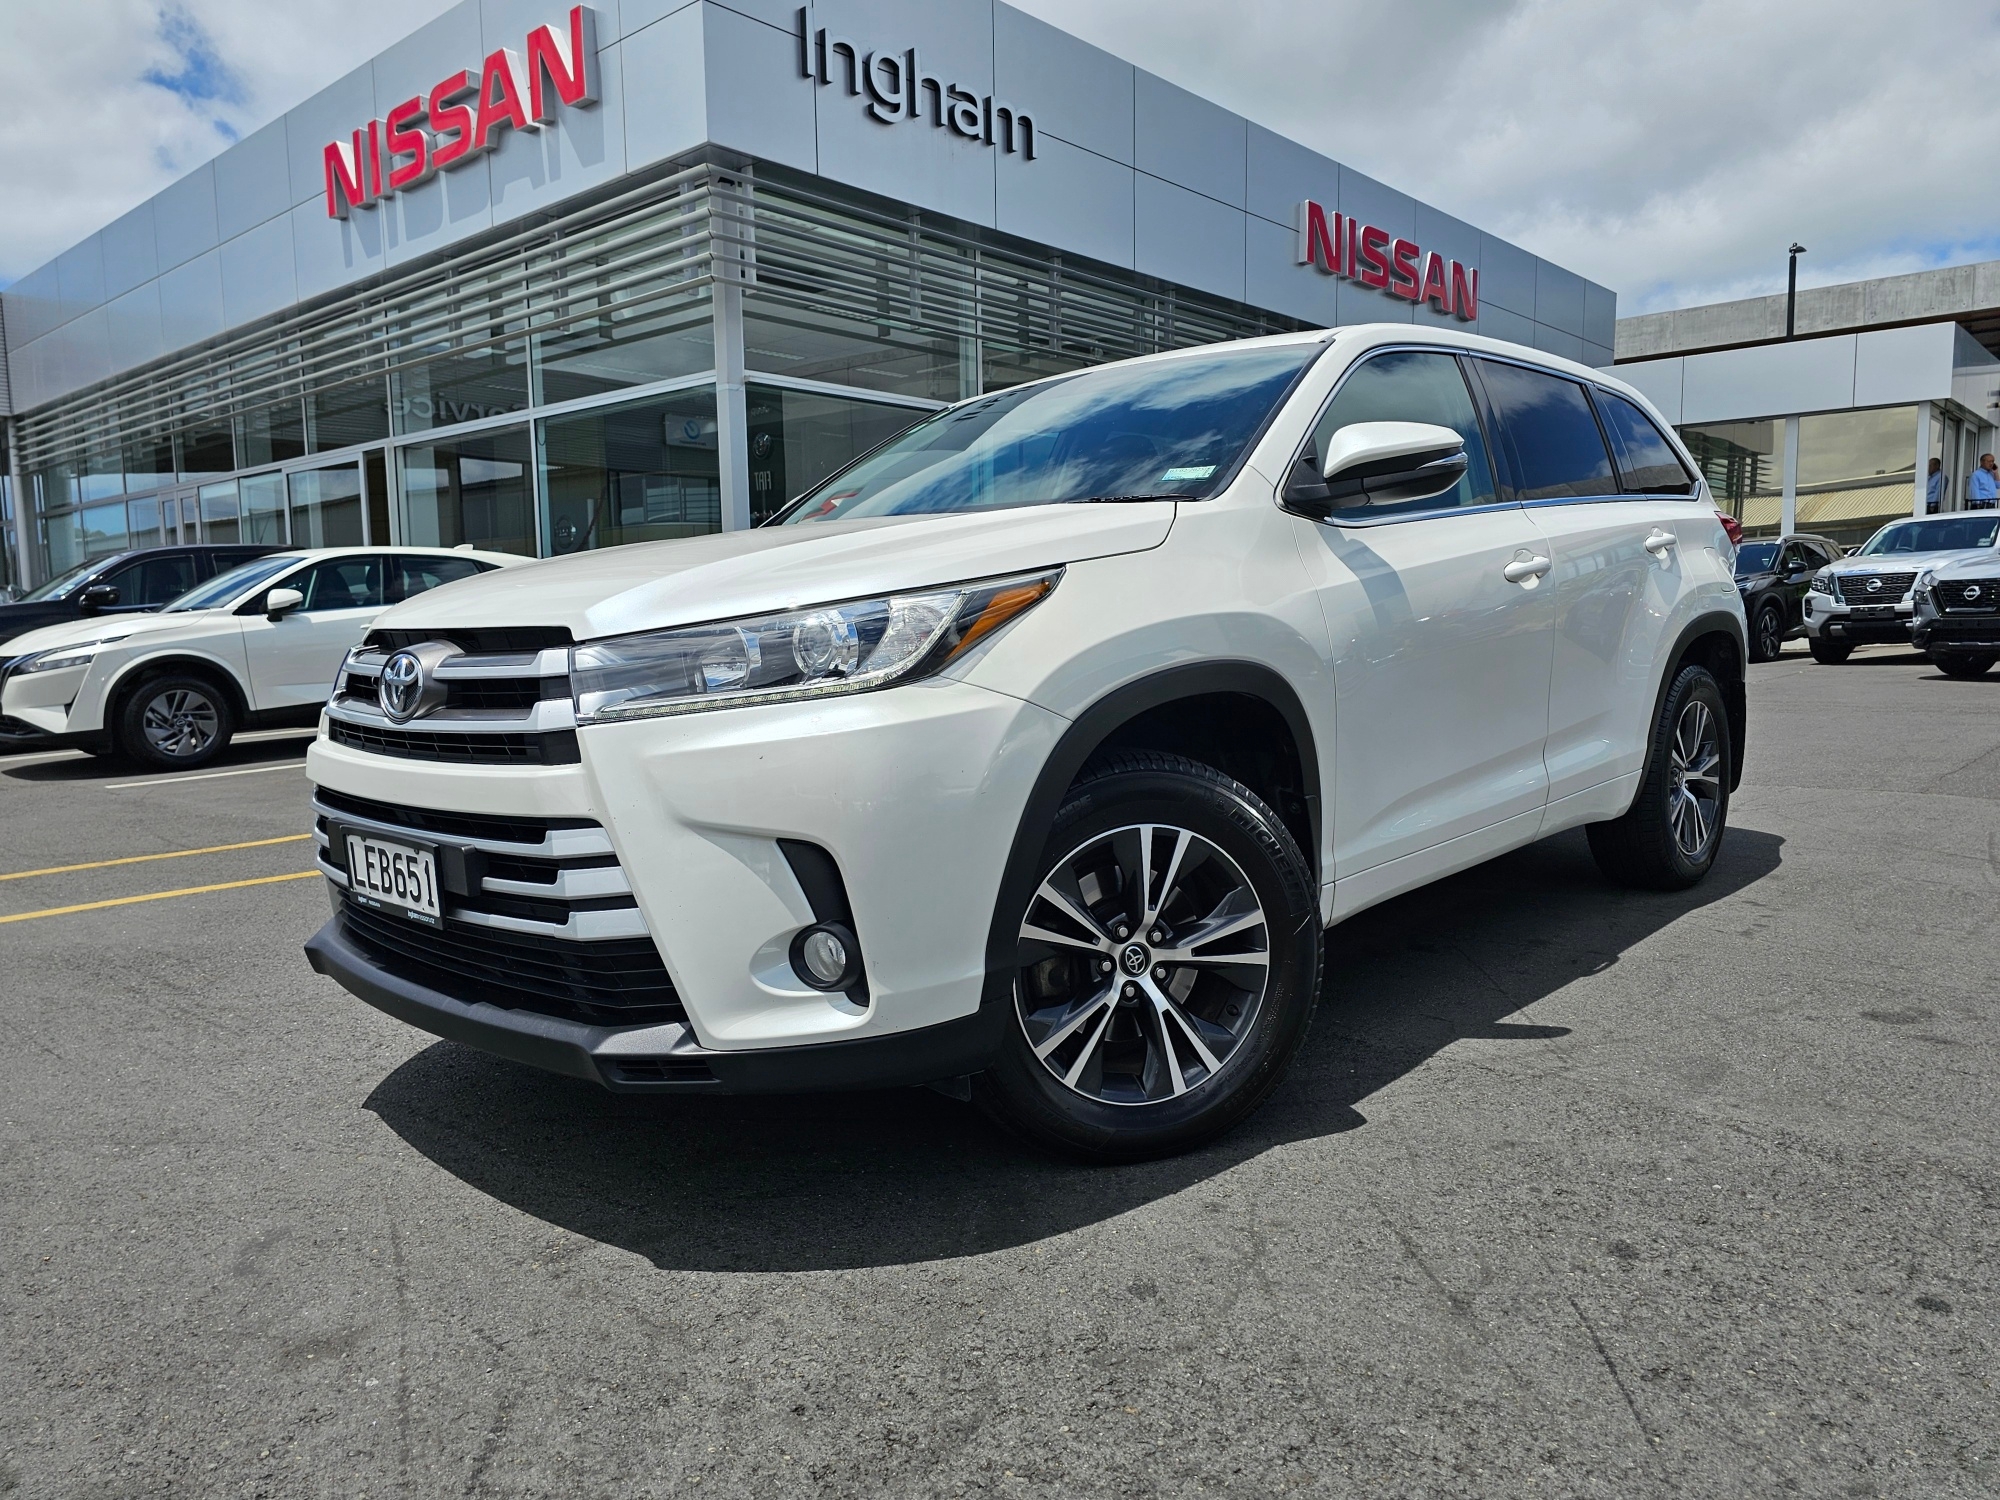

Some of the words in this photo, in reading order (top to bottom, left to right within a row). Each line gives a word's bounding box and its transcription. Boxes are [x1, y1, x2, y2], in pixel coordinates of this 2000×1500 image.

[324, 3, 595, 220] NISSAN
[800, 6, 1038, 160] Ingham
[1300, 199, 1478, 321] NISSAN
[349, 841, 435, 908] LEB651
